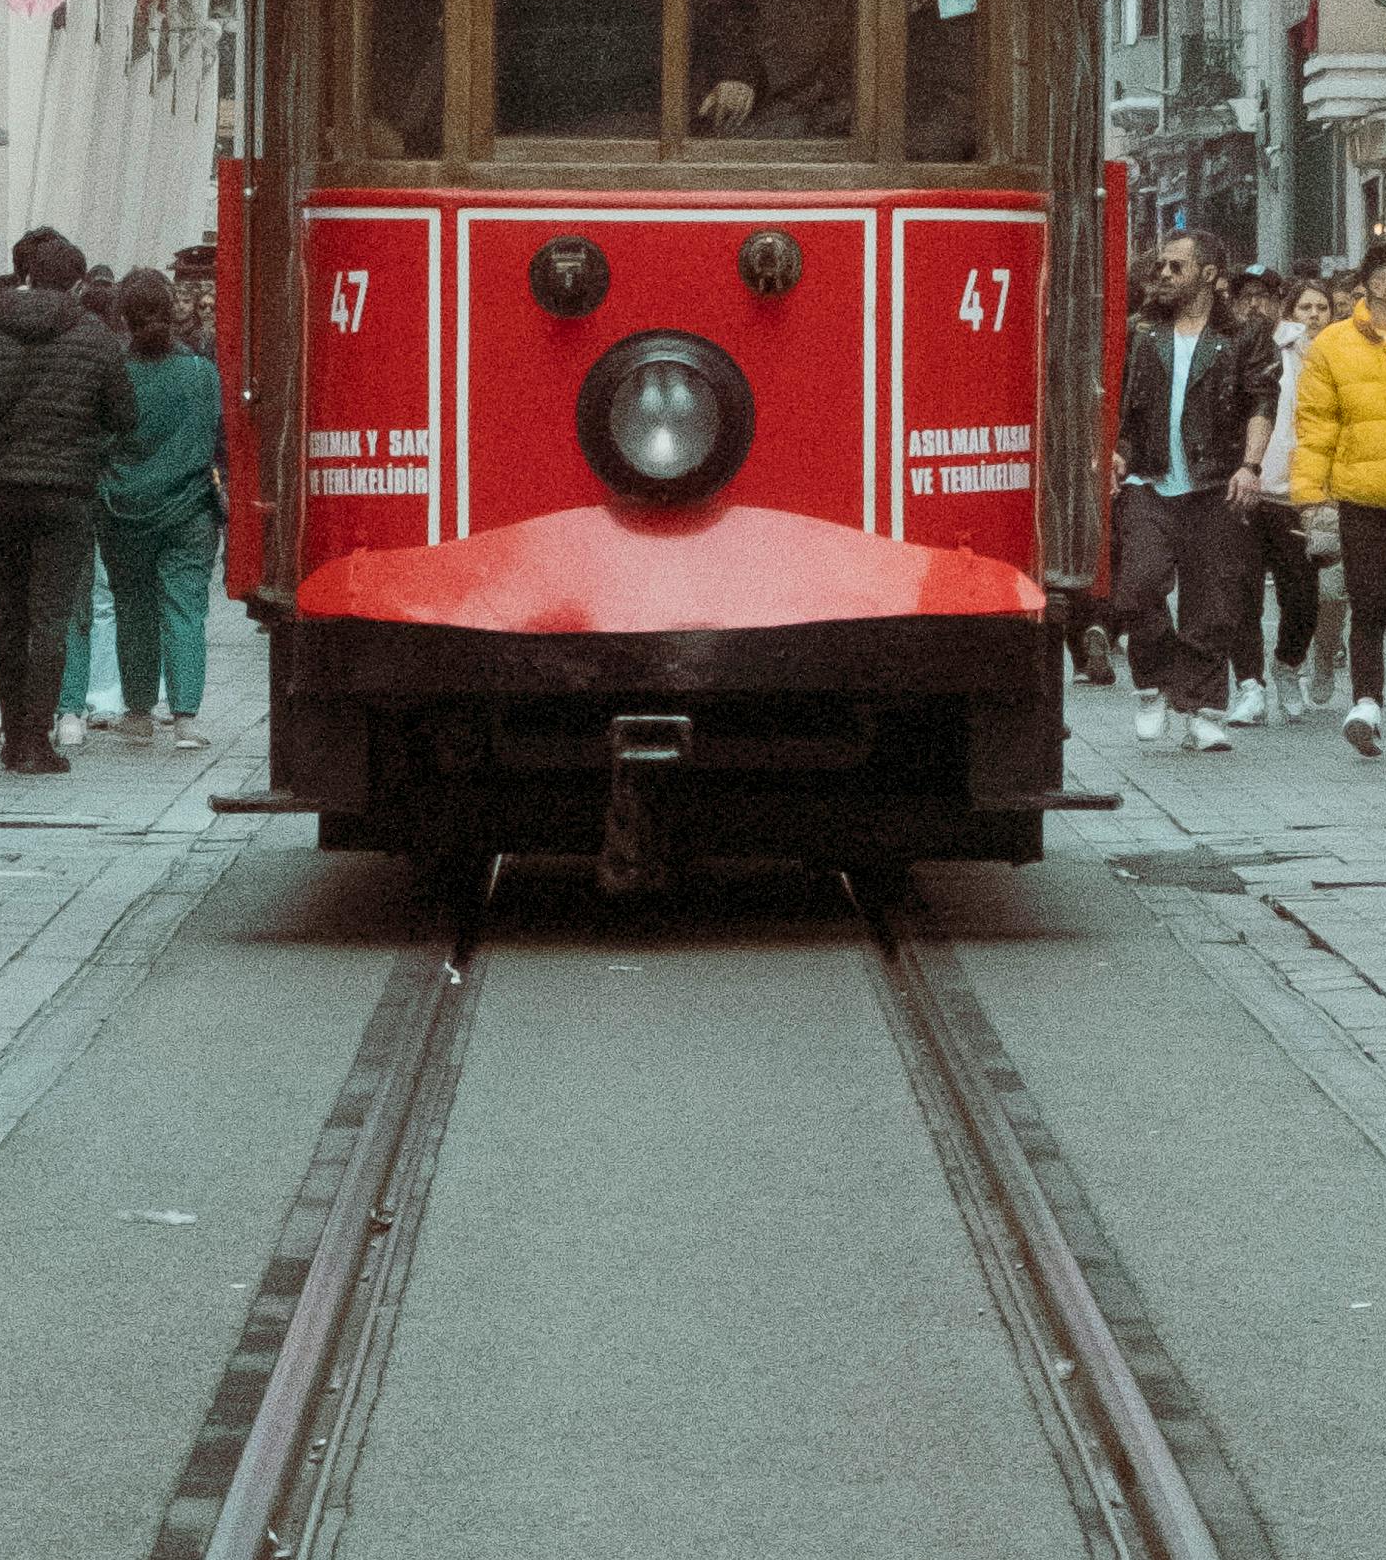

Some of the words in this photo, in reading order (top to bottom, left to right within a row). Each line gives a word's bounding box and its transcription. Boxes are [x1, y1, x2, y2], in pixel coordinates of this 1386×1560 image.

[331, 270, 369, 333] 47
[959, 268, 1011, 331] 47
[909, 426, 991, 457] ASILMAK
[994, 424, 1031, 452] YASAK
[910, 466, 934, 495] VE
